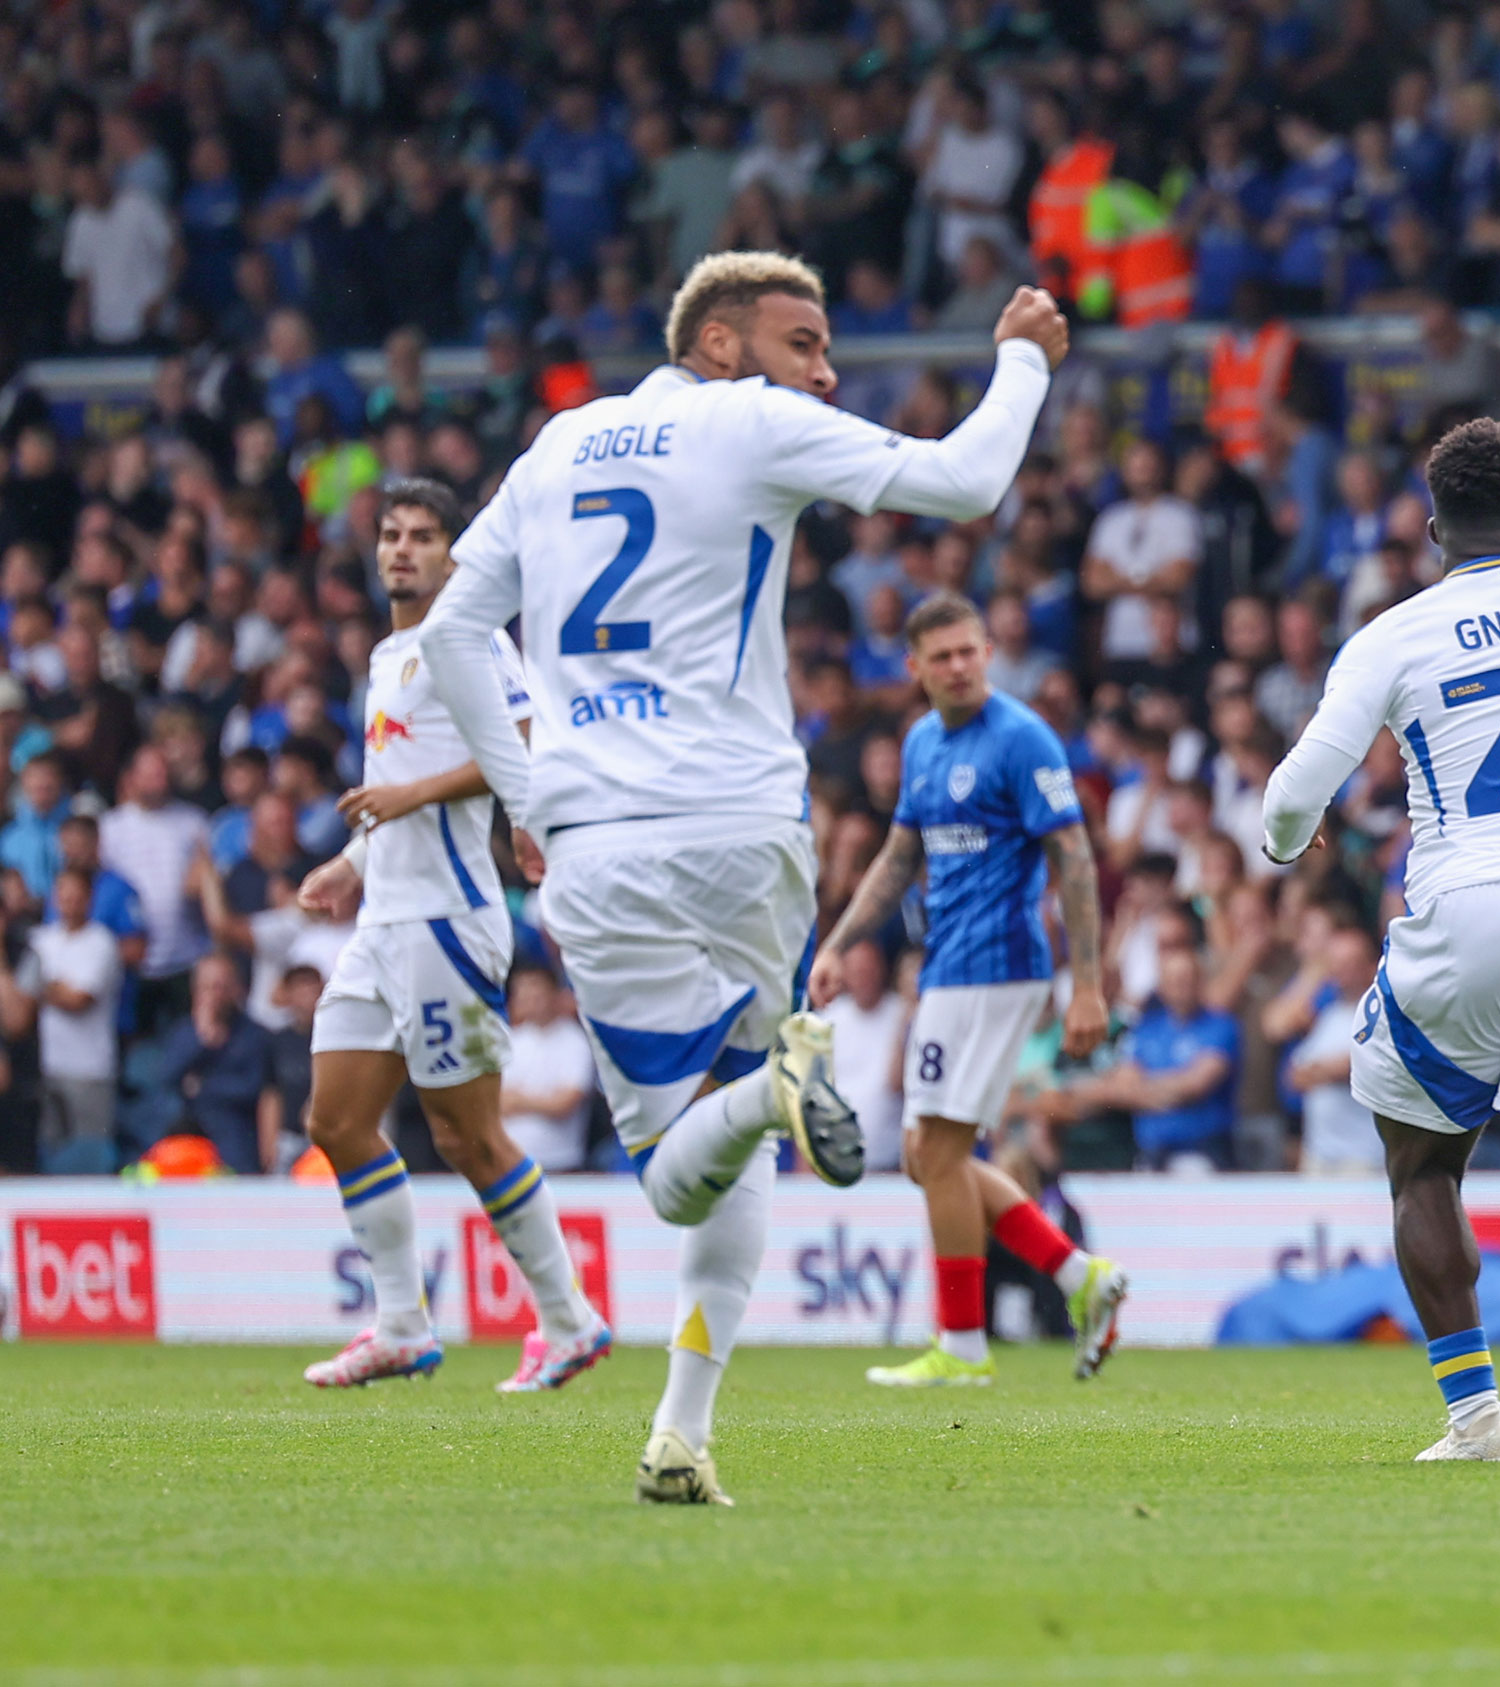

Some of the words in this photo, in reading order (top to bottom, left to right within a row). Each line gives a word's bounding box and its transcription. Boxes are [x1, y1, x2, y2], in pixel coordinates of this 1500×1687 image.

[572, 423, 676, 466] BOGLE
[560, 487, 656, 656] 2
[570, 680, 669, 728] amt
[422, 999, 453, 1046] 5
[920, 1041, 943, 1083] 8
[23, 1222, 148, 1322] bet
[797, 1221, 915, 1341] sky
